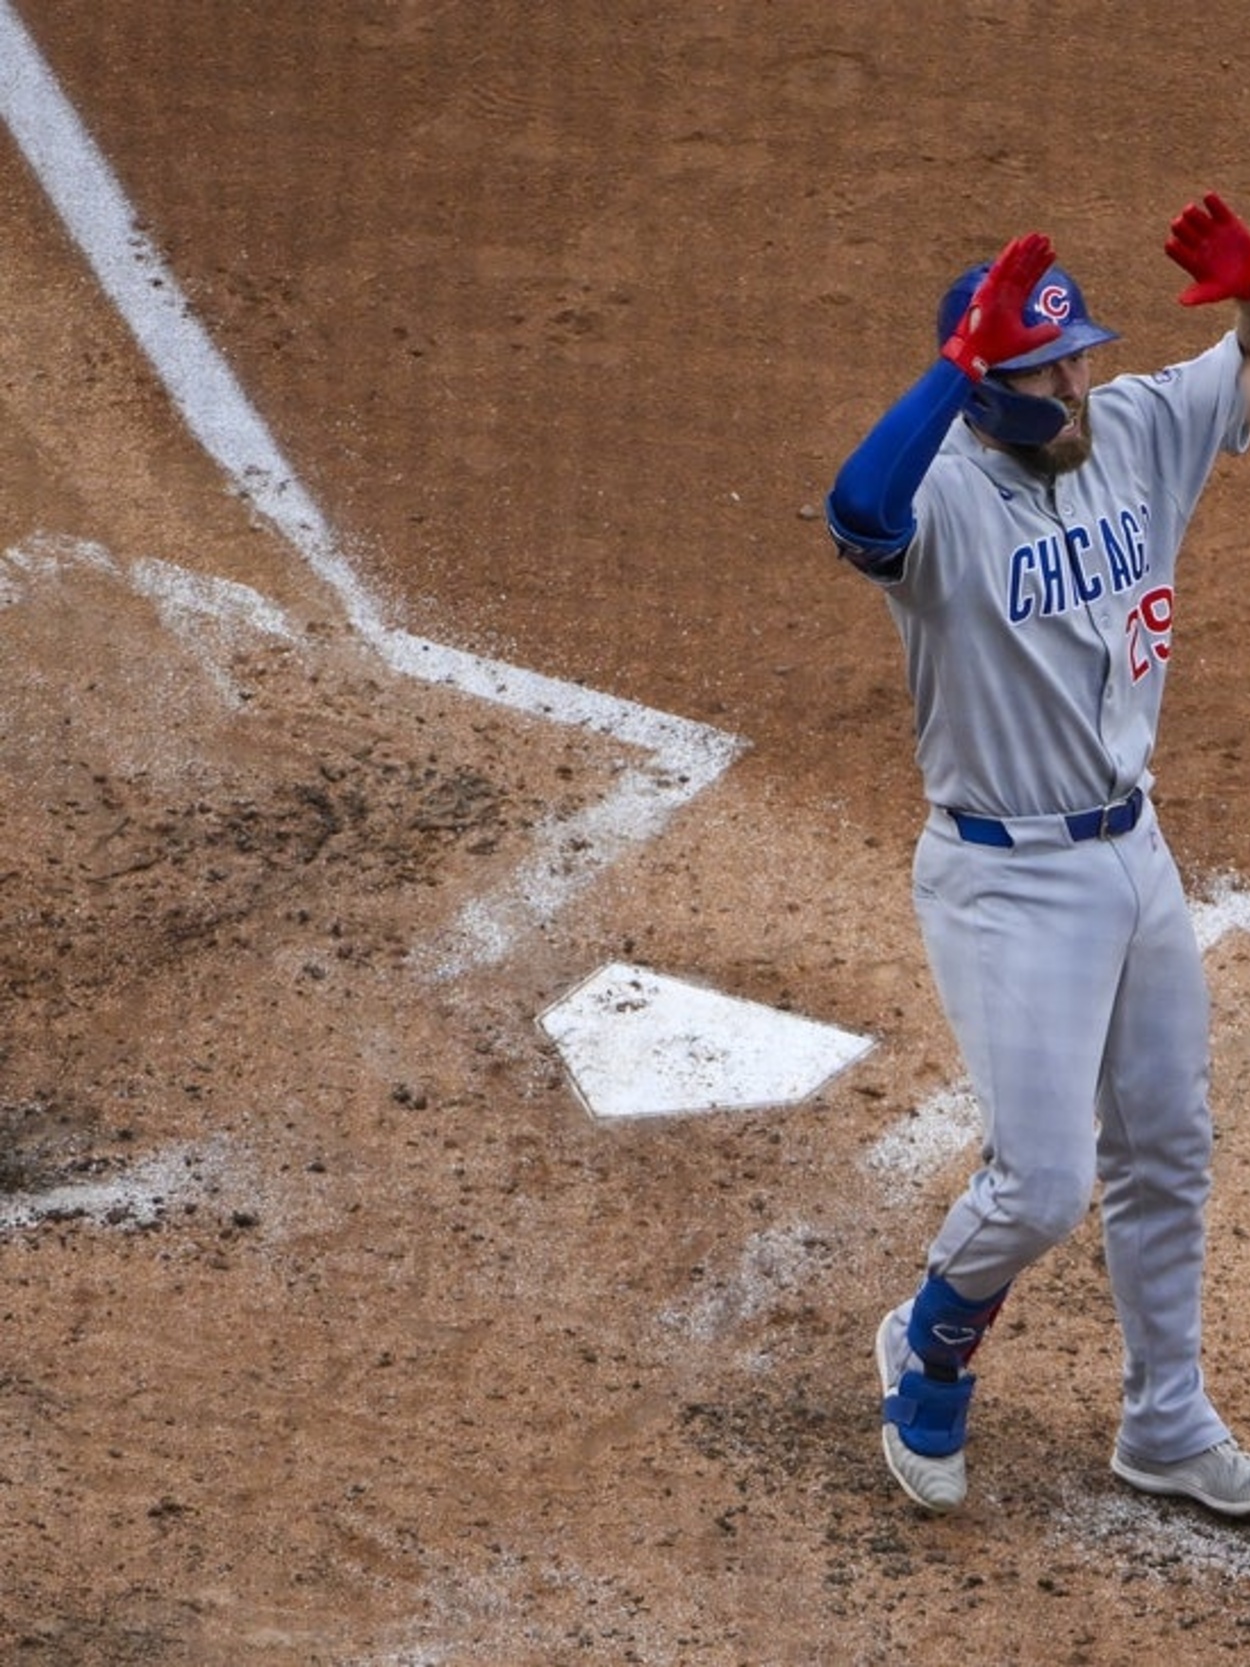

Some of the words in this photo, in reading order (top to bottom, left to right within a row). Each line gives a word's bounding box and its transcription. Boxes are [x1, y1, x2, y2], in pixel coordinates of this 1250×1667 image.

[1040, 285, 1070, 320] C
[1008, 504, 1150, 624] CHCAG
[1125, 584, 1174, 685] 29
